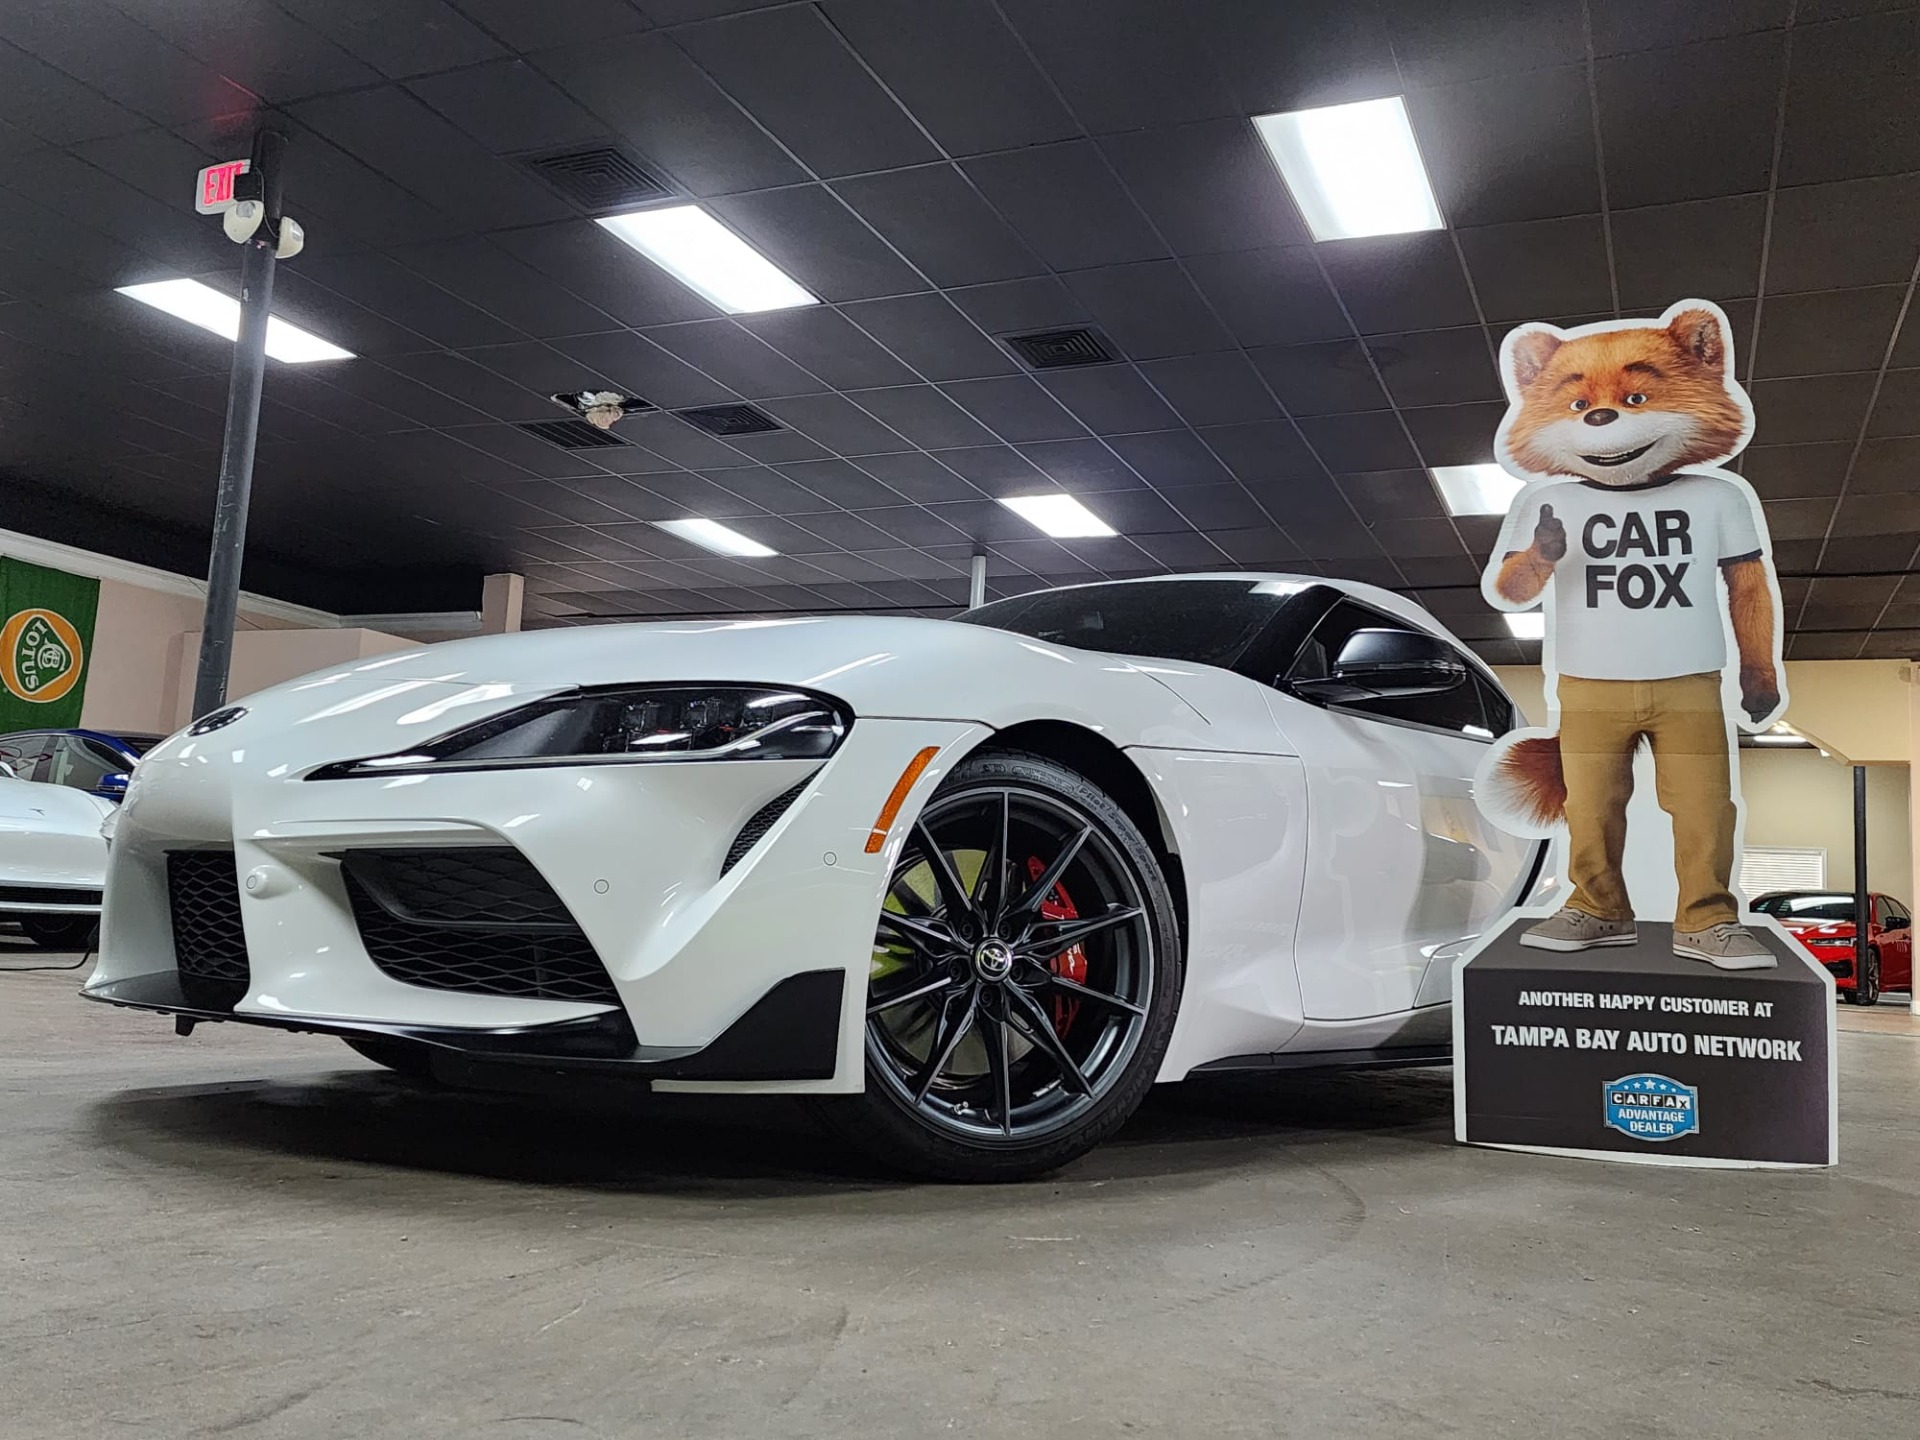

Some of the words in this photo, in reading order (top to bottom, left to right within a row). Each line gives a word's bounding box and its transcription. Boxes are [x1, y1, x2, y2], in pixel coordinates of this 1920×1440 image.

[1582, 509, 1692, 559] CAR
[1586, 562, 1693, 609] FOX
[21, 619, 49, 690] LOTUS
[1518, 991, 1595, 1008] ANOTHER
[1599, 994, 1655, 1011] HAPPY
[1660, 996, 1749, 1016] CUSTOMER
[1753, 1002, 1773, 1018] AT
[1491, 1025, 1570, 1048] TAMPA
[1576, 1028, 1620, 1050] BAY
[1627, 1031, 1687, 1054] AUTO
[1694, 1034, 1802, 1061] NETWORK
[1612, 1092, 1690, 1109] CARFAX
[1618, 1108, 1685, 1122] ADVANTAGE
[1629, 1121, 1674, 1134] DEALER
